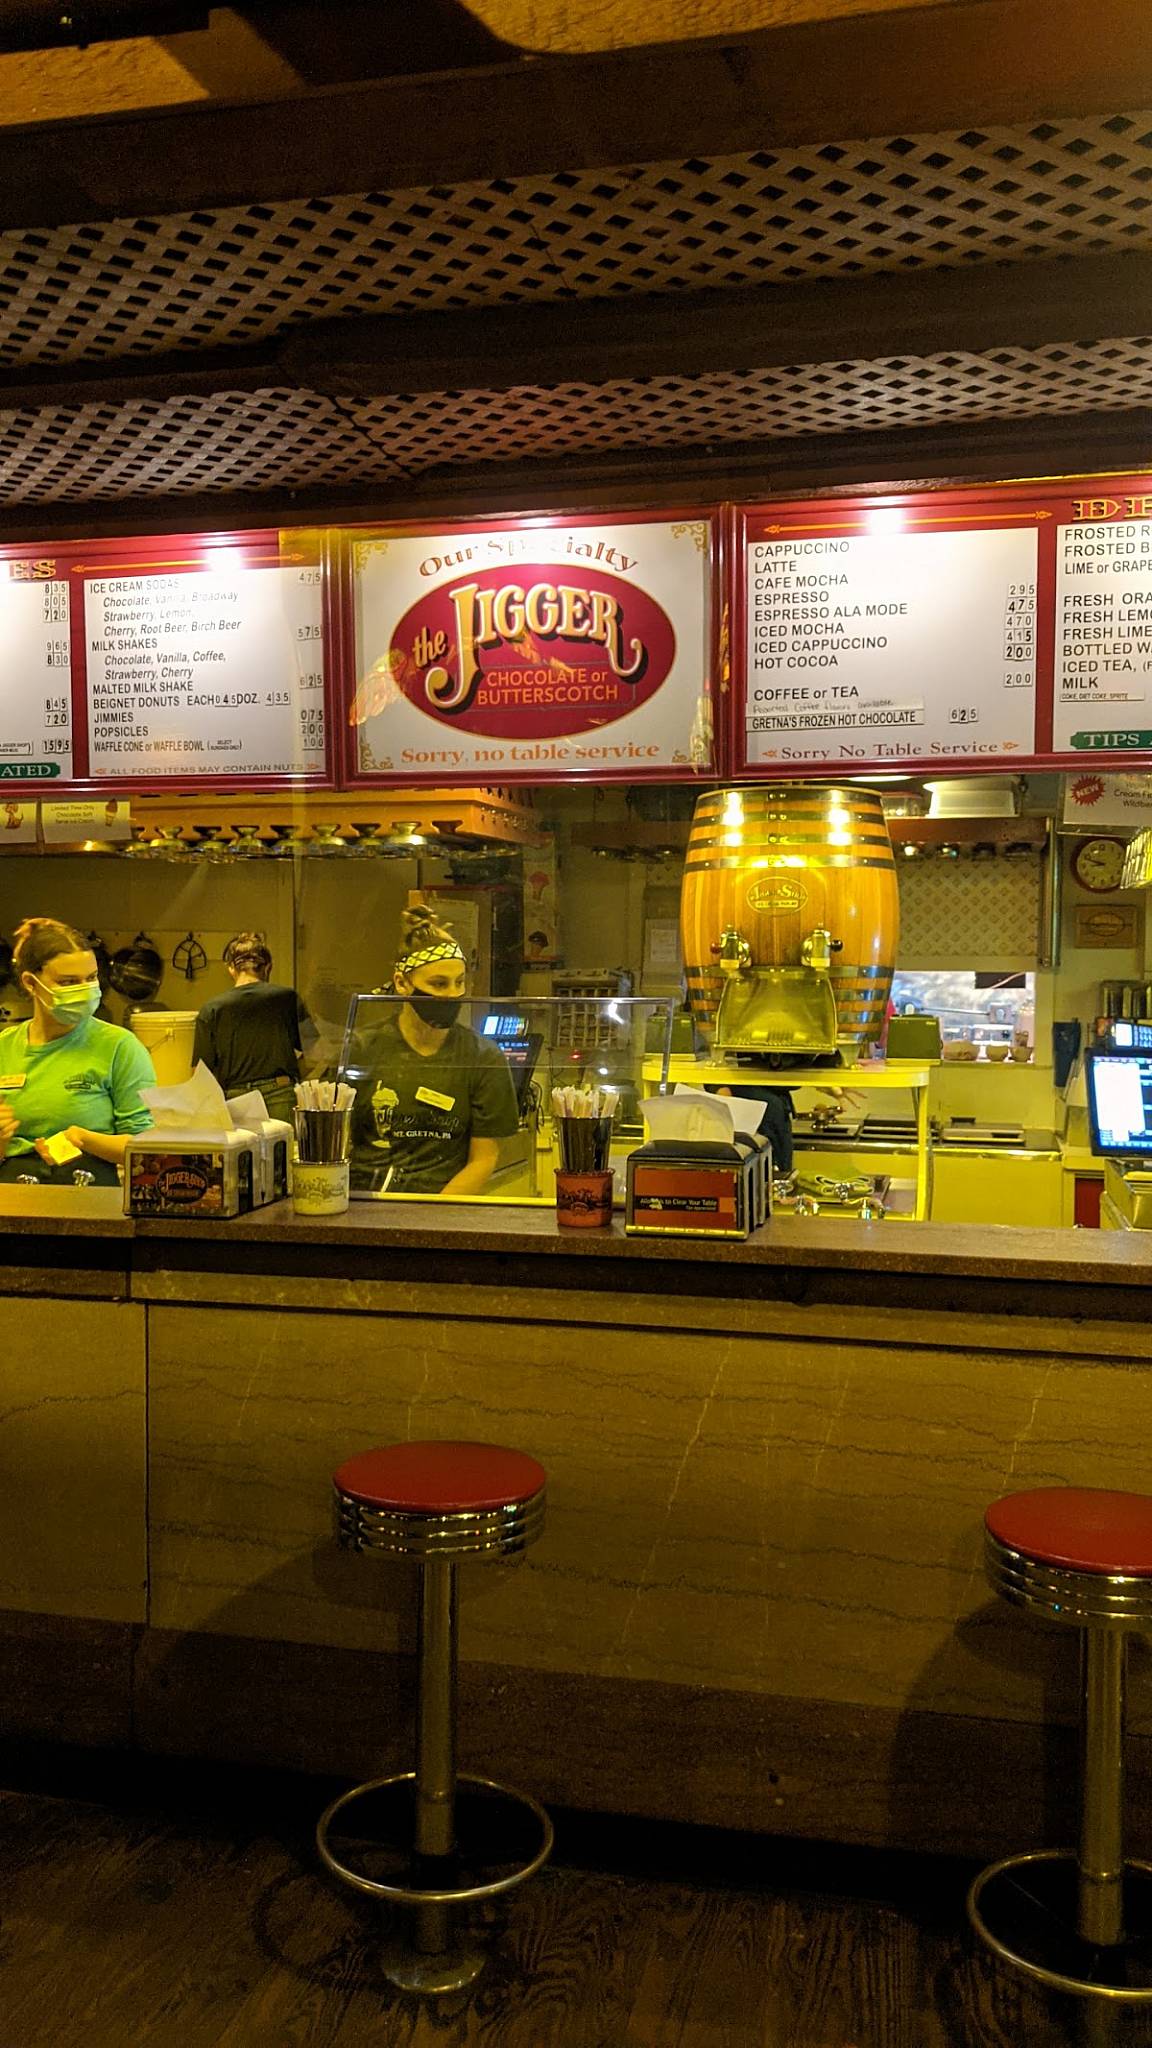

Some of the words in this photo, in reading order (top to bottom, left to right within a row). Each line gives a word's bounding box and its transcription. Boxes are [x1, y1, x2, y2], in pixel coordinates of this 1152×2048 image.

[1065, 526, 1135, 540] FROSTED
[419, 545, 478, 577] Our
[487, 536, 638, 572] Spialty
[755, 541, 850, 558] CAPPUCCINO
[1064, 543, 1135, 557] FROSTED
[755, 561, 797, 574] LATTE
[1065, 562, 1094, 574] LIME
[1097, 564, 1109, 573] or
[299, 573, 321, 582] 475
[755, 577, 791, 590] CAFE
[796, 574, 849, 587] MOCHA
[90, 583, 106, 594] ICE
[109, 581, 143, 592] CREAM
[1010, 585, 1035, 596] 295
[103, 597, 151, 608] Chocolate,
[755, 591, 829, 606] ESPRESSO
[1064, 594, 1113, 607] FRESH
[755, 607, 830, 622] ESPRESSO
[833, 605, 862, 618] ALA
[865, 603, 908, 616] MODE
[1008, 600, 1035, 612] 475
[45, 610, 66, 620] 720
[1006, 616, 1032, 627] 470
[1064, 610, 1113, 623] FRESH
[1118, 609, 1152, 621] LEM
[104, 626, 138, 638] Cherry,
[140, 624, 162, 634] Root
[191, 621, 216, 632] Birch
[218, 619, 243, 631] Beer
[298, 627, 321, 638] 575
[755, 625, 787, 638] ICED
[792, 623, 845, 636] MOCHA
[1063, 627, 1113, 640] FRESH
[1006, 630, 1032, 642] 415
[92, 640, 115, 652] MILK
[118, 638, 158, 650] SHAKES
[412, 626, 449, 667] the
[425, 583, 647, 709] JIGGER
[755, 641, 787, 654] ICED
[792, 636, 888, 652] CAPPUCCINO
[1006, 646, 1032, 658] 200
[1063, 643, 1132, 656] BOTTLED
[1137, 642, 1152, 654] W
[105, 655, 154, 666] Chocolate,
[156, 653, 190, 663] Vanilla,
[193, 650, 227, 662] Coffee,
[754, 658, 783, 670] HOT
[787, 655, 838, 669] COCOA
[1063, 661, 1098, 673] ICED
[1103, 659, 1136, 672] TEA,
[105, 669, 159, 681] Strawberry,
[161, 667, 193, 679] Cherry
[487, 668, 586, 687] CHOCOLATE
[591, 671, 608, 682] or
[1006, 673, 1032, 684] 200
[93, 683, 131, 695] MALTED
[133, 682, 157, 693] MILK
[159, 681, 193, 692] SHAKE
[1062, 677, 1098, 689] MILK
[478, 685, 618, 705] BUTTERSCOTCH
[754, 688, 809, 701] COFFEE
[813, 689, 828, 699] or
[831, 686, 859, 698] TEA
[93, 697, 136, 709] BEIGNET
[138, 696, 180, 707] DONUTS
[187, 695, 214, 706] EACH
[47, 713, 67, 724] 720
[94, 712, 134, 723] JIMMIES
[301, 710, 323, 720] 075
[752, 716, 798, 729] GRETNA'S
[800, 714, 835, 728] FROZEN
[838, 713, 856, 726] HOT
[859, 711, 916, 725] CHOCOLATE
[951, 709, 977, 721] 625
[94, 726, 149, 738] POPSICLES
[44, 740, 70, 751] 1595
[94, 741, 123, 752] WAFFLE
[124, 741, 144, 752] CONE
[154, 740, 182, 751] WAFFLE
[184, 740, 204, 751] BOWL
[1083, 733, 1140, 747] TIPS
[475, 750, 504, 762] no
[511, 744, 569, 760] table
[575, 742, 660, 759] service
[781, 747, 830, 761] Sorry
[839, 745, 865, 757] No
[873, 743, 921, 757] Table
[930, 741, 998, 754] Service
[1, 765, 51, 777] ATED
[110, 767, 129, 775] ALL
[130, 767, 161, 775] FOOD
[164, 766, 195, 774] ITEMS
[199, 765, 220, 774] MAY
[223, 764, 271, 773] CONTAIN
[274, 763, 304, 772] NUTS
[1076, 783, 1100, 798] NEW
